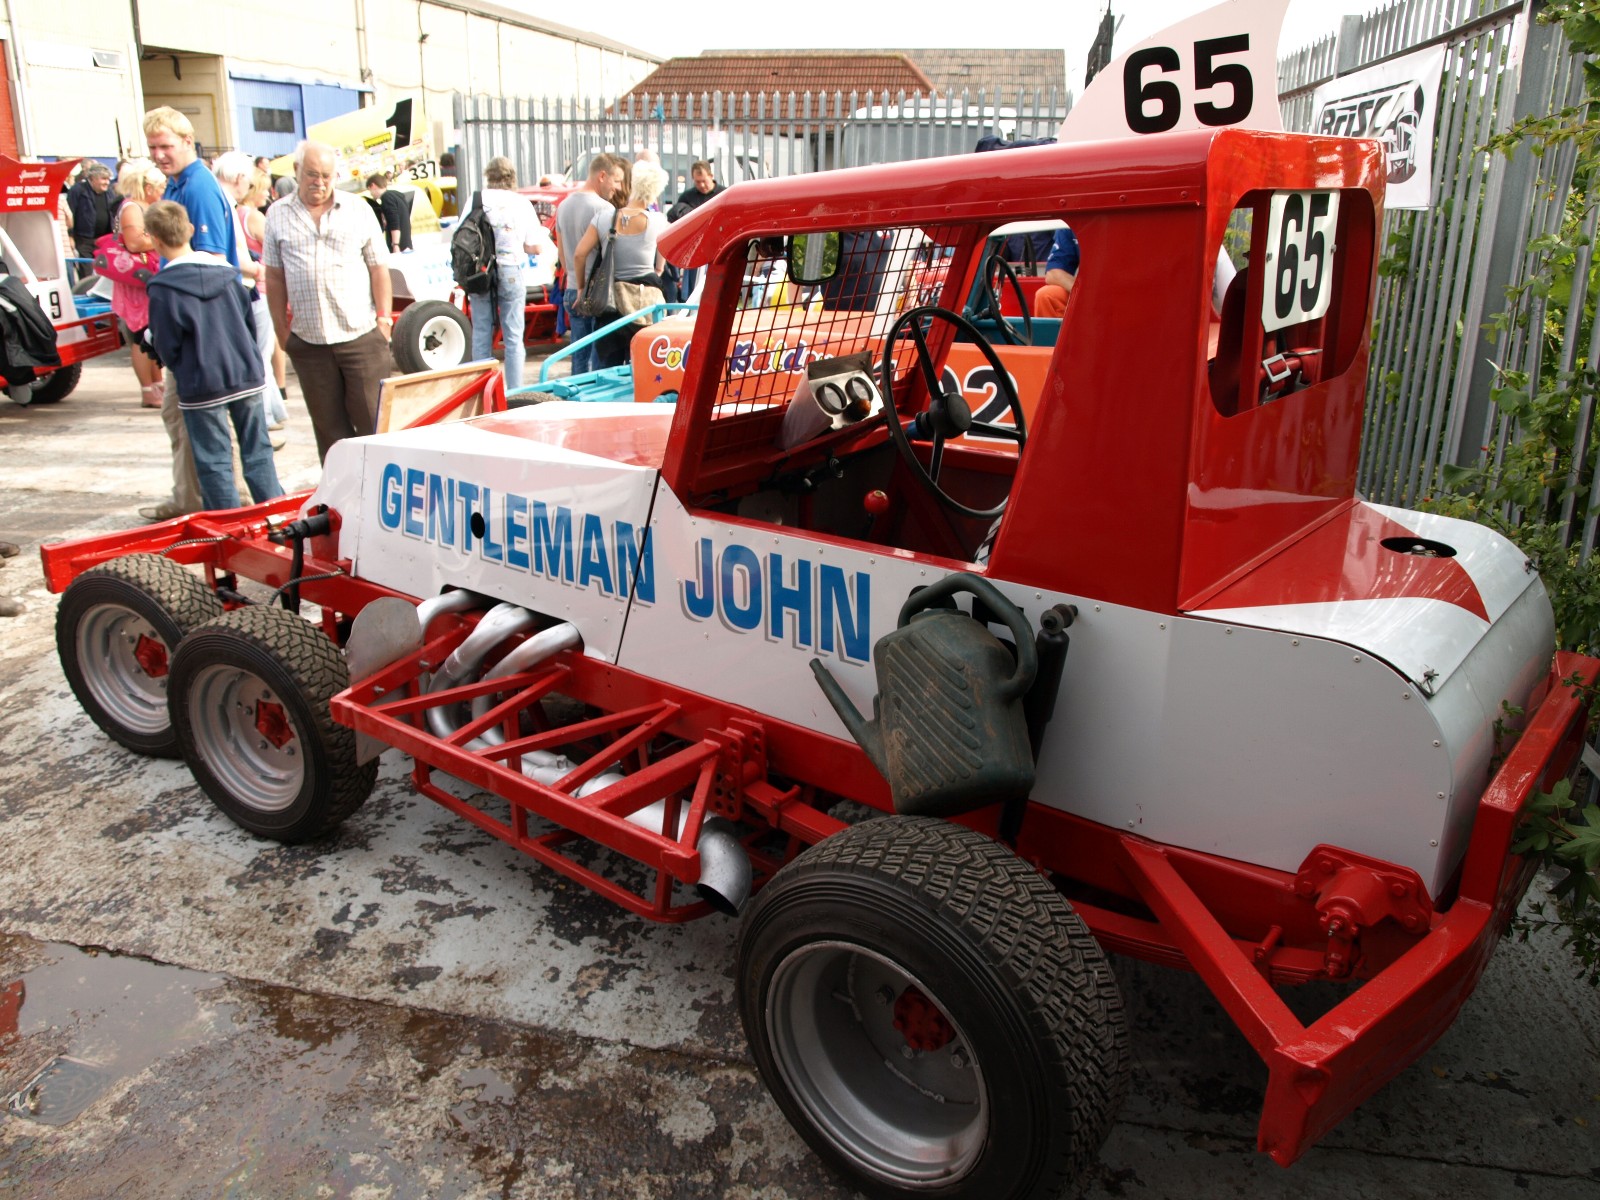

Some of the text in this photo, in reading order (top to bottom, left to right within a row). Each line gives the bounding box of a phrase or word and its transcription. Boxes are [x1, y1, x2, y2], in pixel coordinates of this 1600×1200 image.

[385, 98, 413, 151] 1
[1123, 33, 1254, 135] 65
[409, 160, 437, 181] 337
[1275, 193, 1330, 319] 65
[378, 462, 872, 666] GENTLEMAN JOHN
